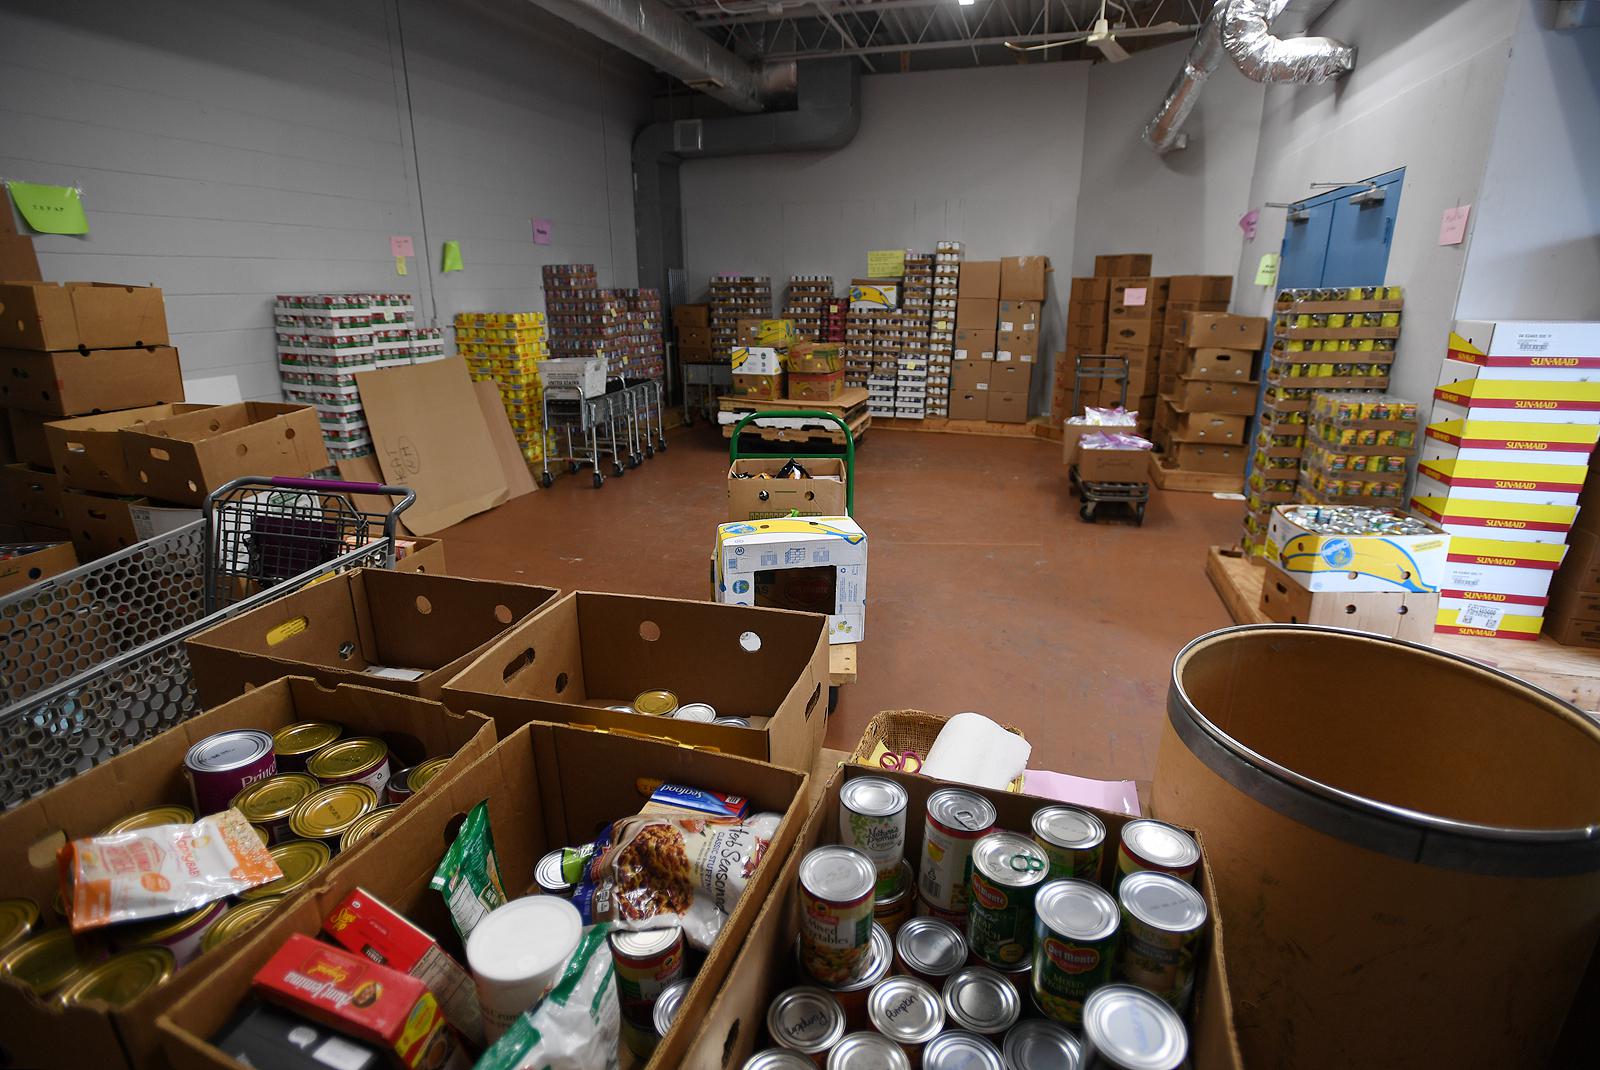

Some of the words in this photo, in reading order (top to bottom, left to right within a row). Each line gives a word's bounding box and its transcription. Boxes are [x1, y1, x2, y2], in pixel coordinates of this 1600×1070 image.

[1530, 357, 1579, 366] SUN-MAID
[1515, 400, 1558, 409] SUN-MAID
[1505, 441, 1548, 450] SUN-MAID
[1495, 480, 1536, 490] SUN-MAID
[1484, 519, 1526, 529] SUN-MAID
[1475, 556, 1516, 566] SUN-MAID
[1463, 591, 1507, 602] SUN-MAID
[1458, 627, 1496, 637] SUN-MAID
[660, 784, 704, 799] Seafood
[714, 849, 741, 916] Seasoned
[1048, 944, 1062, 959] Del
[1063, 951, 1097, 965] Monte
[320, 986, 353, 1010] Aunt
[885, 995, 918, 1023] Pumpkin
[787, 1011, 828, 1036] Pumpkin
